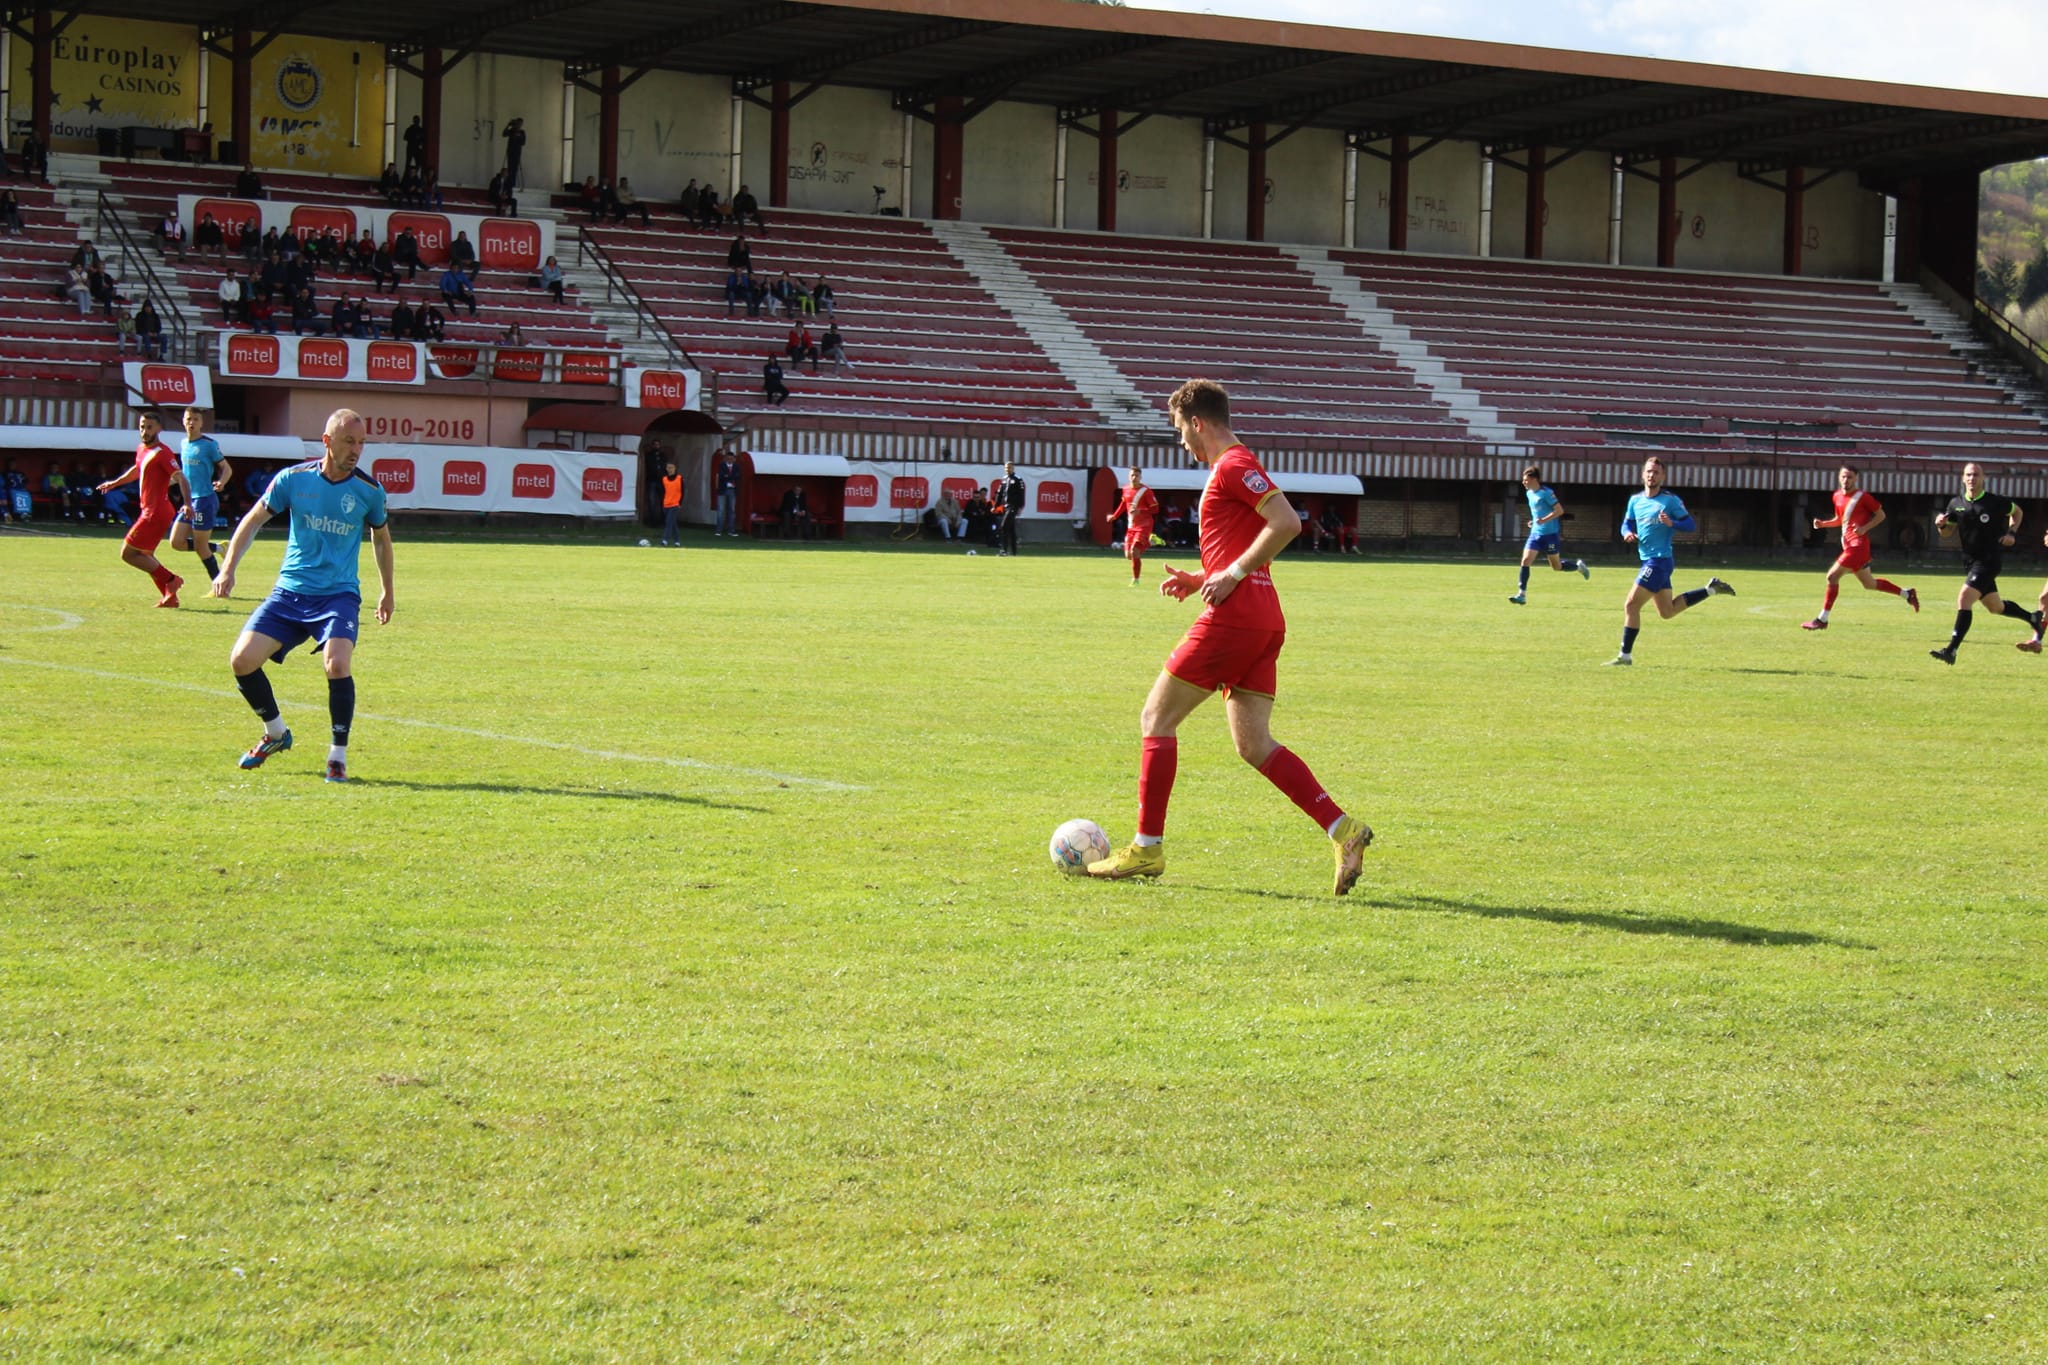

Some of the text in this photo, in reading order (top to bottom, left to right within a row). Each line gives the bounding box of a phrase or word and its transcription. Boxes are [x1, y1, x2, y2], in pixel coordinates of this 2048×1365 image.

[53, 36, 181, 77] Europlay
[99, 74, 181, 97] CASINOS
[394, 229, 443, 249] :tel
[486, 236, 534, 256] m:tel
[233, 348, 273, 363] m:tel
[303, 351, 343, 367] m:tel
[372, 353, 410, 370] m:tel
[147, 377, 189, 393] m:tel
[645, 382, 680, 398] m:tel
[365, 417, 474, 440] 1910-2018
[376, 469, 410, 483] m:tel
[447, 472, 480, 485] m:tel
[517, 475, 550, 488] m:tel
[586, 478, 618, 492] m:tel
[845, 484, 873, 497] m:tel
[894, 485, 925, 499] m:tel
[1040, 490, 1069, 504] m:tel
[304, 513, 354, 536] Nektar
